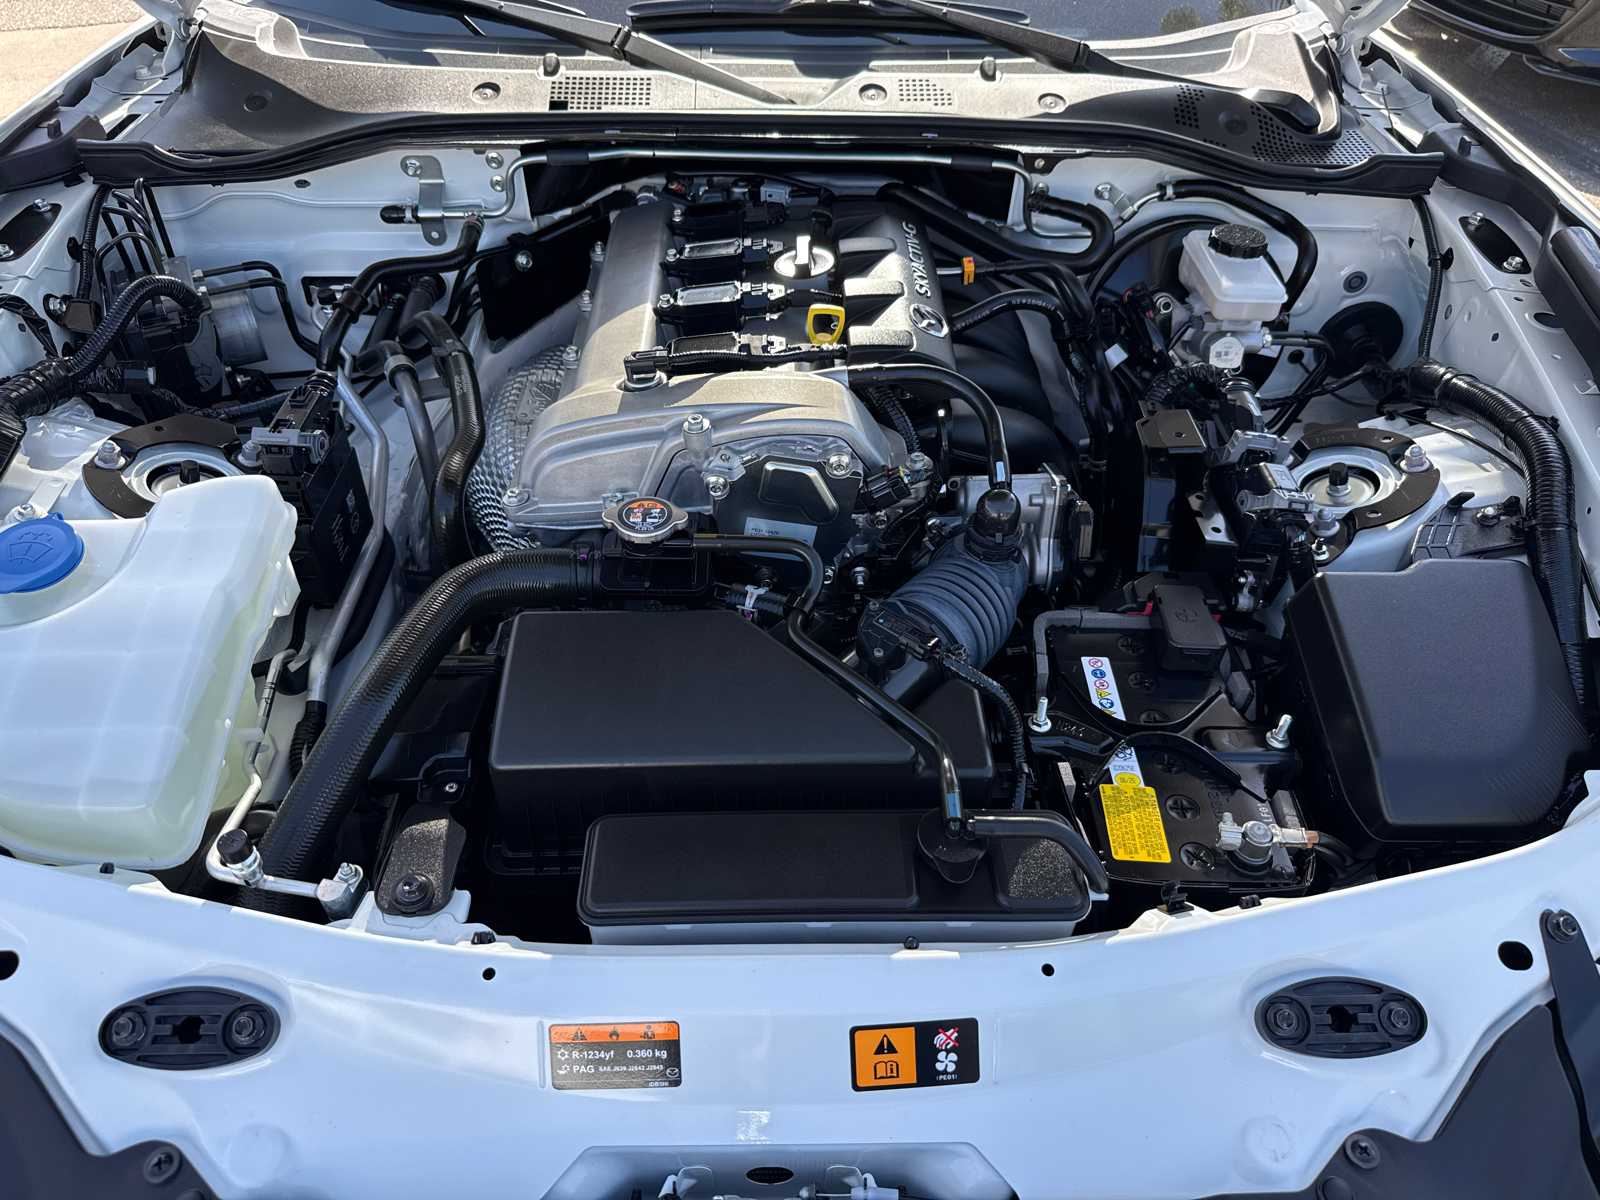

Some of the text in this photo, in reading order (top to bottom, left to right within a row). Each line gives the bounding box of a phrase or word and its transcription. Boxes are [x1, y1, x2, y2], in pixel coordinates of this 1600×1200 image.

[902, 221, 931, 298] SKYACTIV-G
[572, 1049, 667, 1060] R-1234yf 0.360 kg
[573, 1065, 595, 1073] PAG
